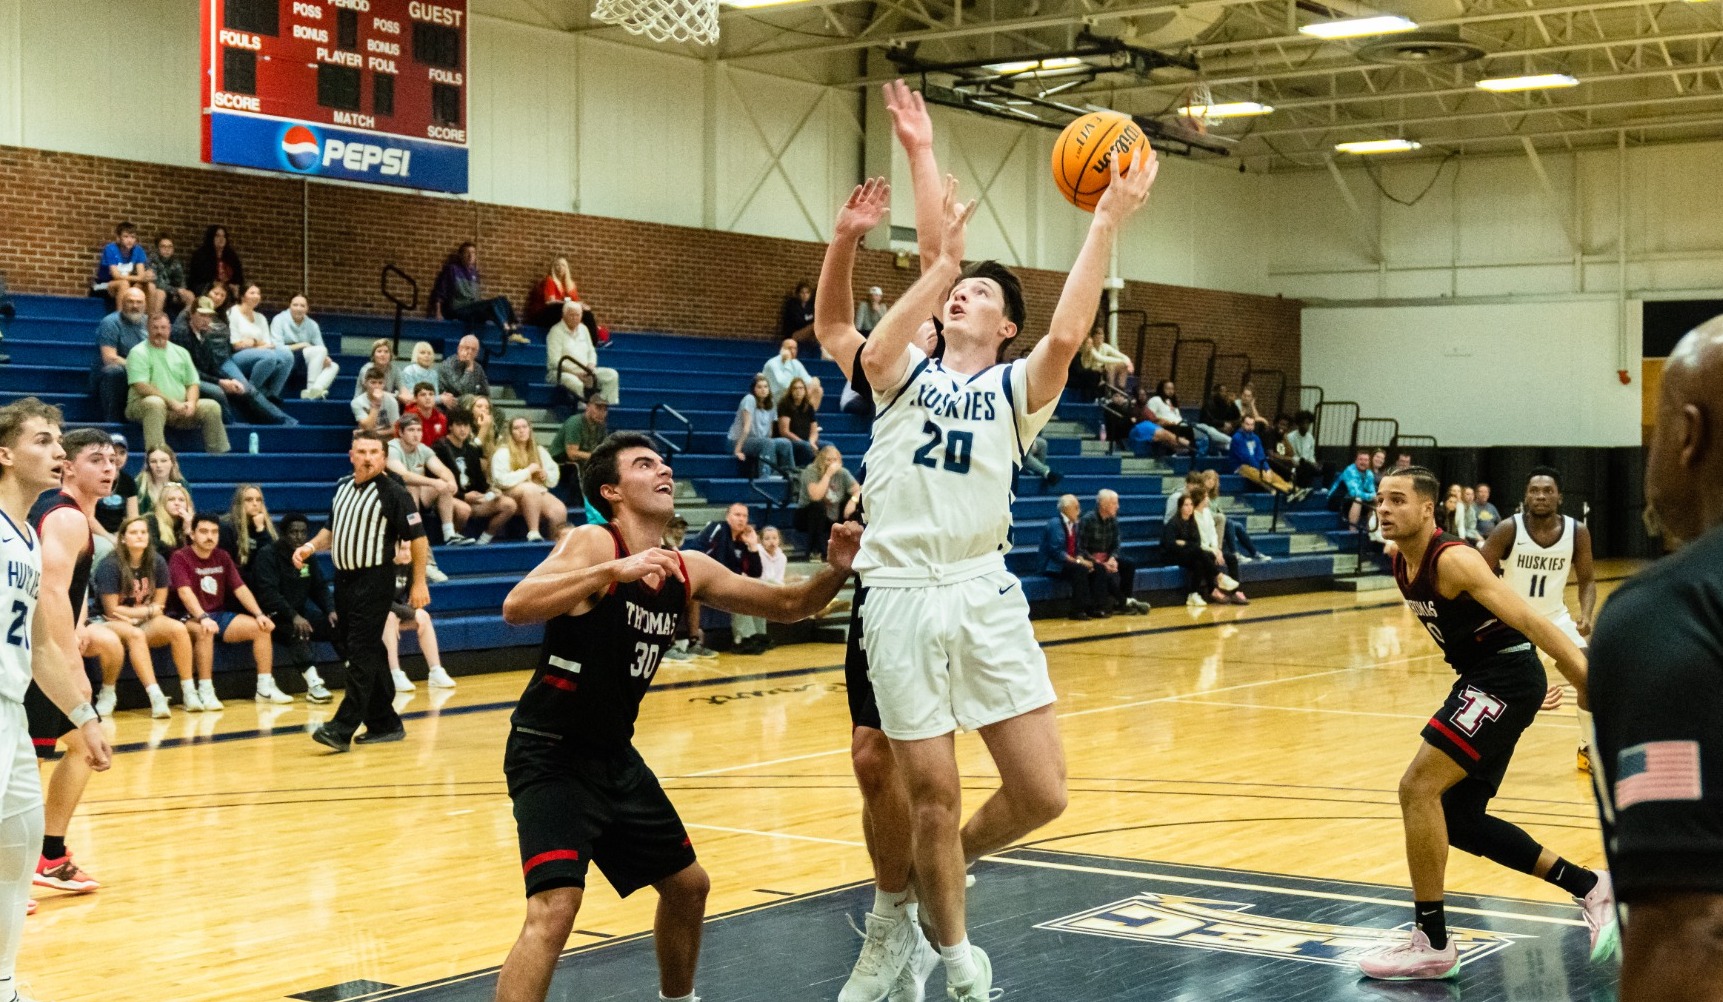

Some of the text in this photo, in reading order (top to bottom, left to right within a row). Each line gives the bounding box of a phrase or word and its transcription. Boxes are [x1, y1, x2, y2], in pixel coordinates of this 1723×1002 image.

[293, 2, 322, 19] POSS
[408, 1, 463, 26] GUEST
[293, 25, 329, 43] BONUS
[373, 17, 400, 34] POSS
[219, 30, 262, 50] FOULS
[367, 39, 400, 56] BONUS
[316, 47, 399, 74] PLAYER FOUL
[428, 68, 463, 85] FOULS
[214, 92, 261, 112] SCORE
[333, 111, 375, 128] MATCH
[427, 126, 466, 142] SCORE
[322, 138, 411, 176] PEPSI
[913, 420, 974, 474] 20
[1517, 554, 1565, 571] HUSKIES
[1529, 575, 1547, 598] 11
[630, 641, 660, 679] 30
[1450, 685, 1507, 737] T
